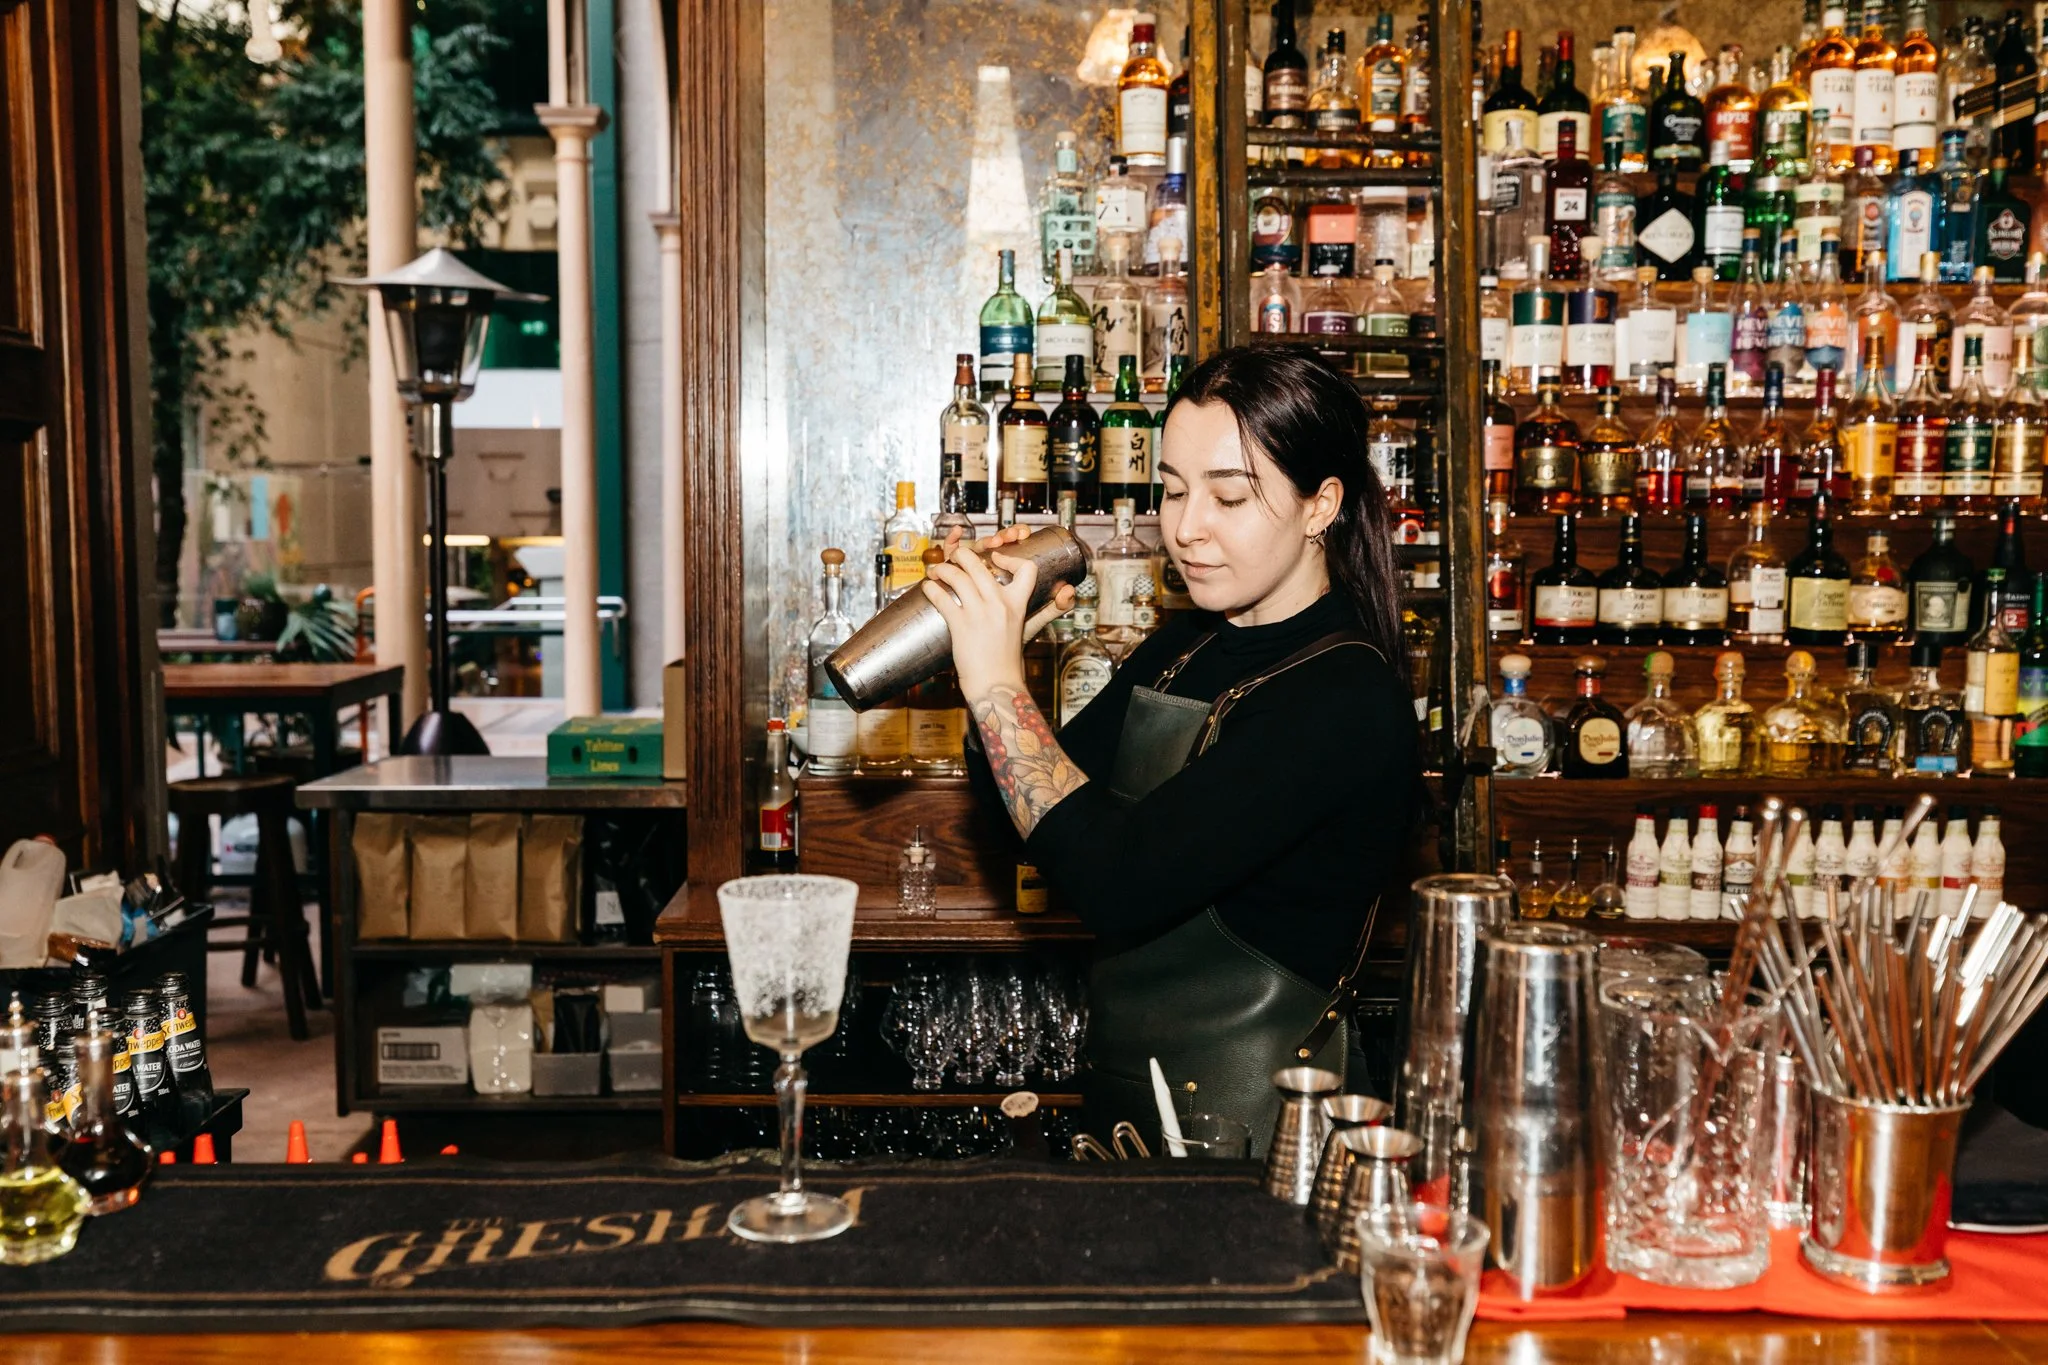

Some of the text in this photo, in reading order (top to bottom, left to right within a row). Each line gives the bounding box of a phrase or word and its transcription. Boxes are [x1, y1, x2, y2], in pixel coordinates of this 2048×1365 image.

[1564, 200, 1579, 212] 24
[1129, 432, 1146, 475] 白州
[590, 759, 620, 773] Limes
[161, 1018, 195, 1035] Schwep
[136, 1062, 161, 1072] WATER
[112, 1083, 131, 1093] ATER
[322, 1186, 878, 1289] GRESH
